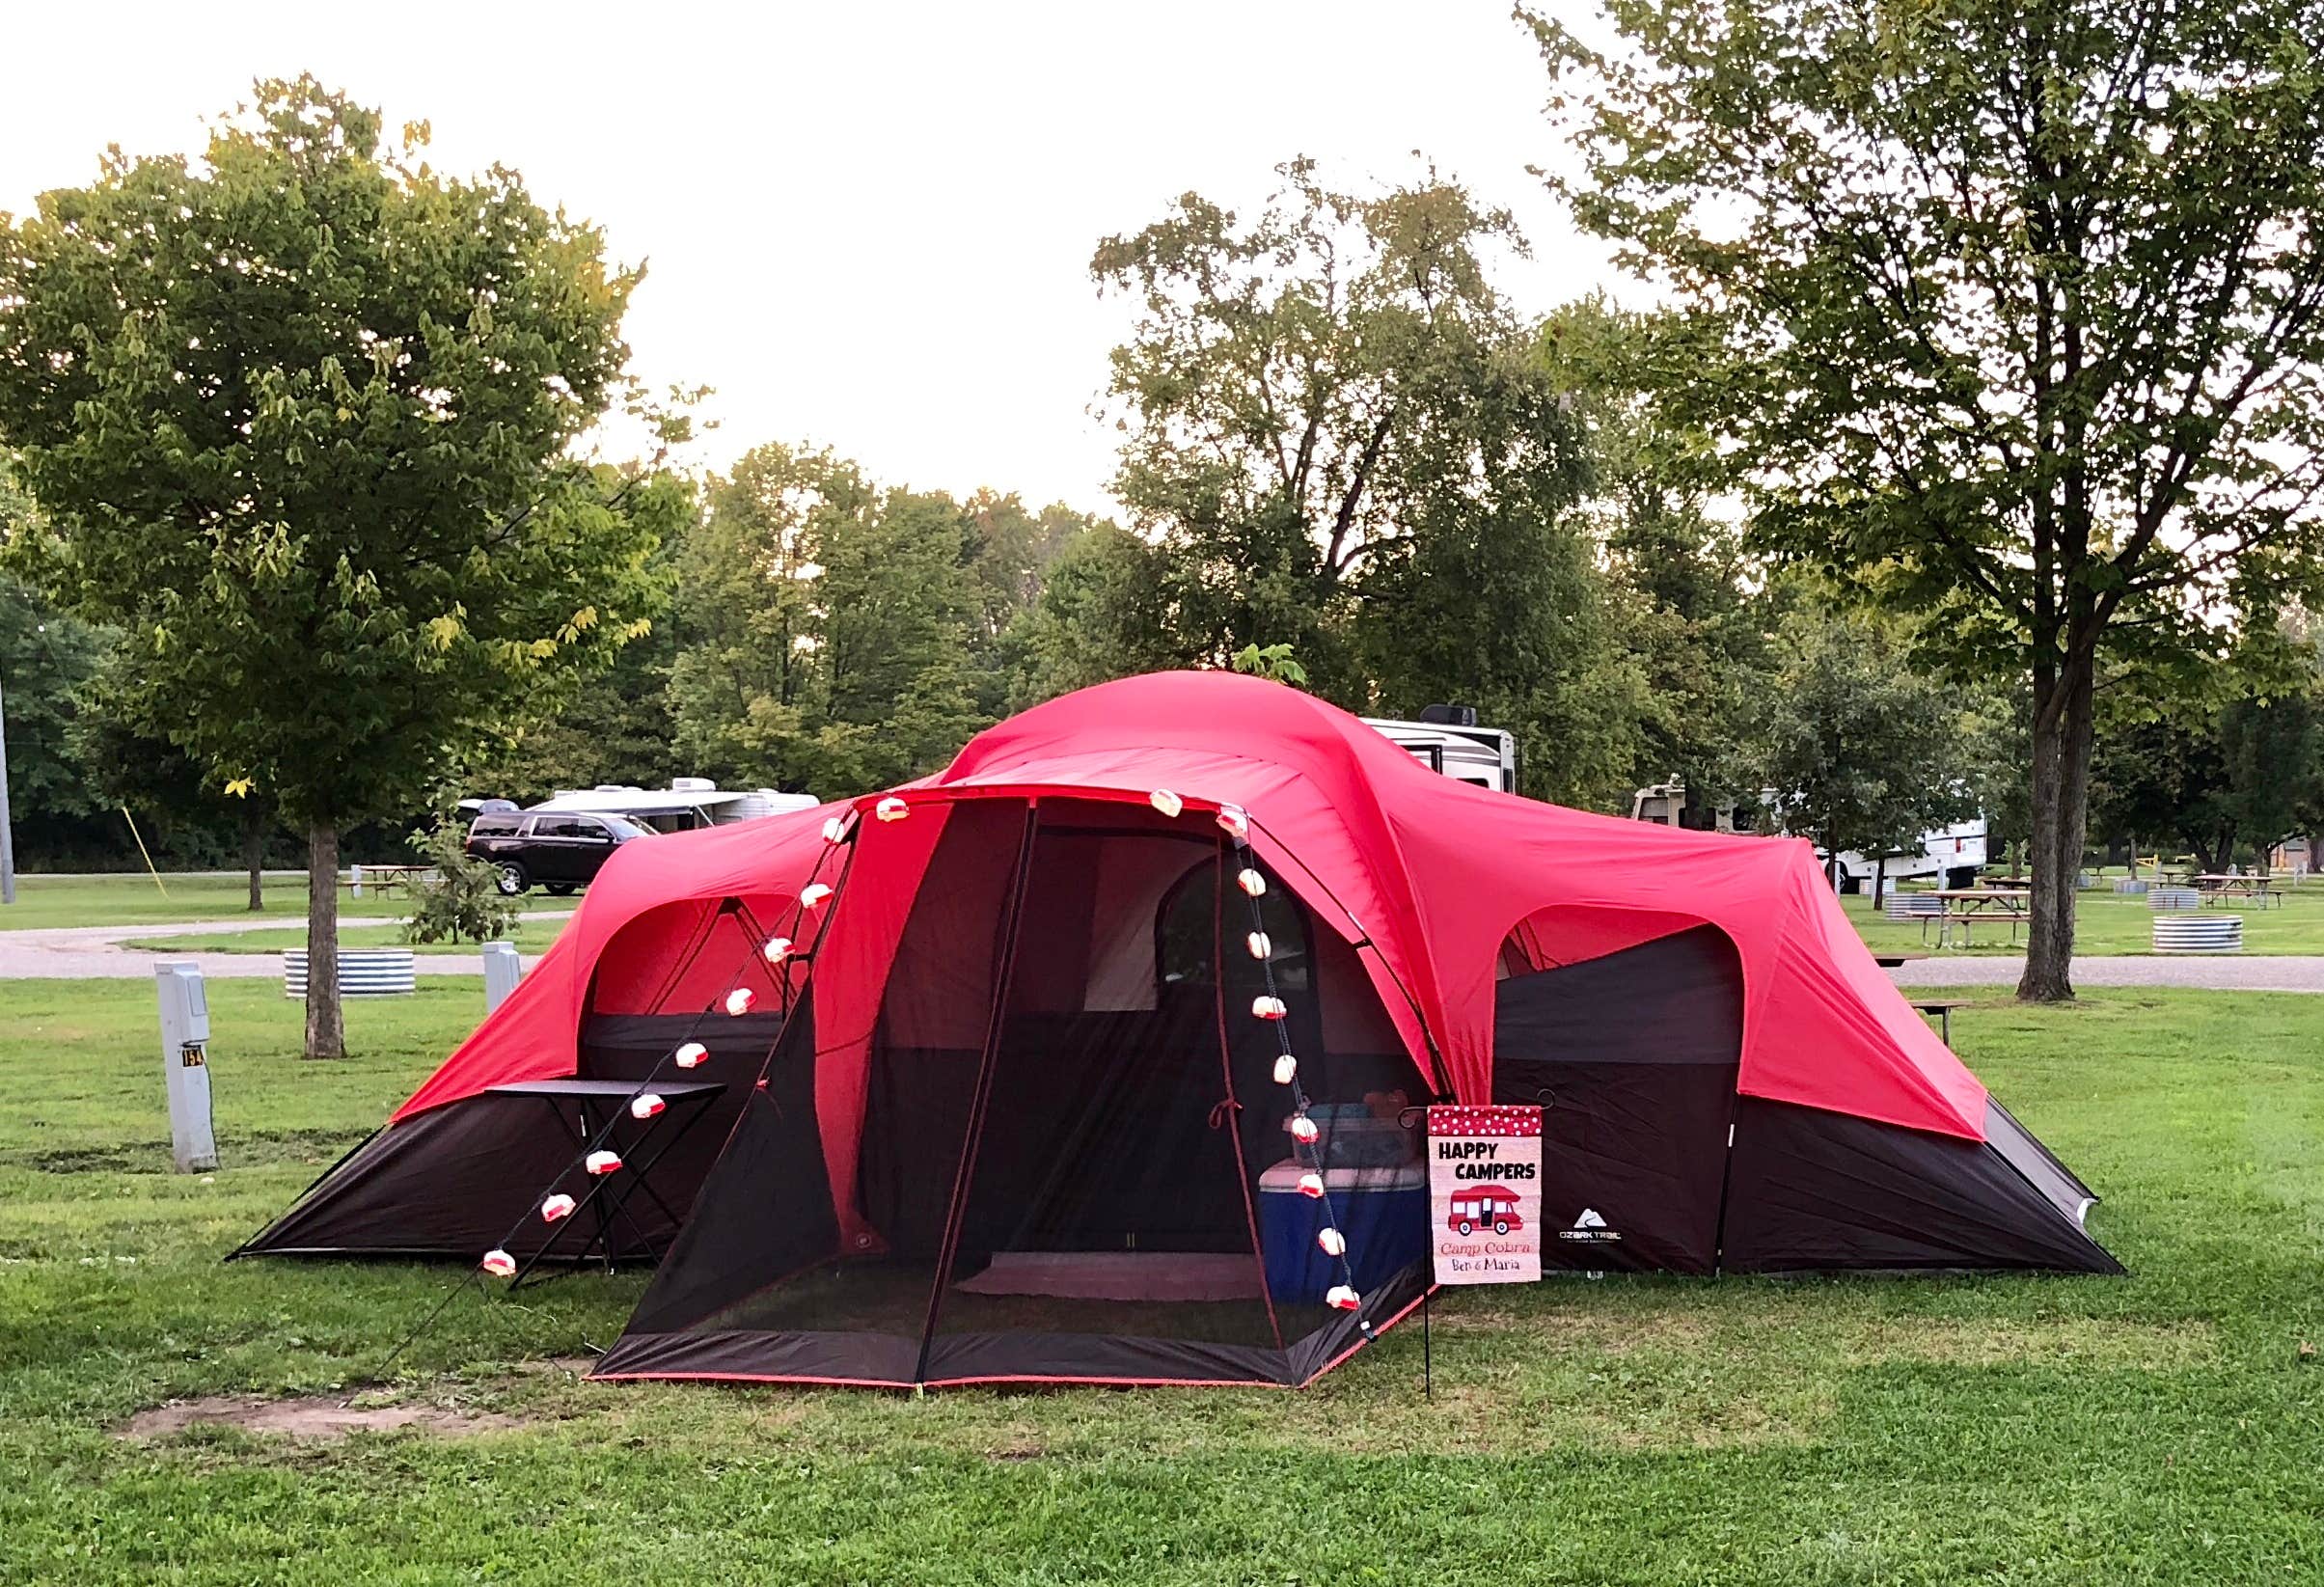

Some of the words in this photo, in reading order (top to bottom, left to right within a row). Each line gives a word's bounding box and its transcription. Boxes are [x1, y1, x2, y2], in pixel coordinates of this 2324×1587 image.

[1438, 1142, 1498, 1159] HAPPY
[1455, 1163, 1536, 1180] CAMPERS
[1440, 1243, 1480, 1257] Camp
[1486, 1242, 1530, 1254] Cobra
[1452, 1258, 1472, 1272] Ben
[1484, 1257, 1520, 1271] Maria
